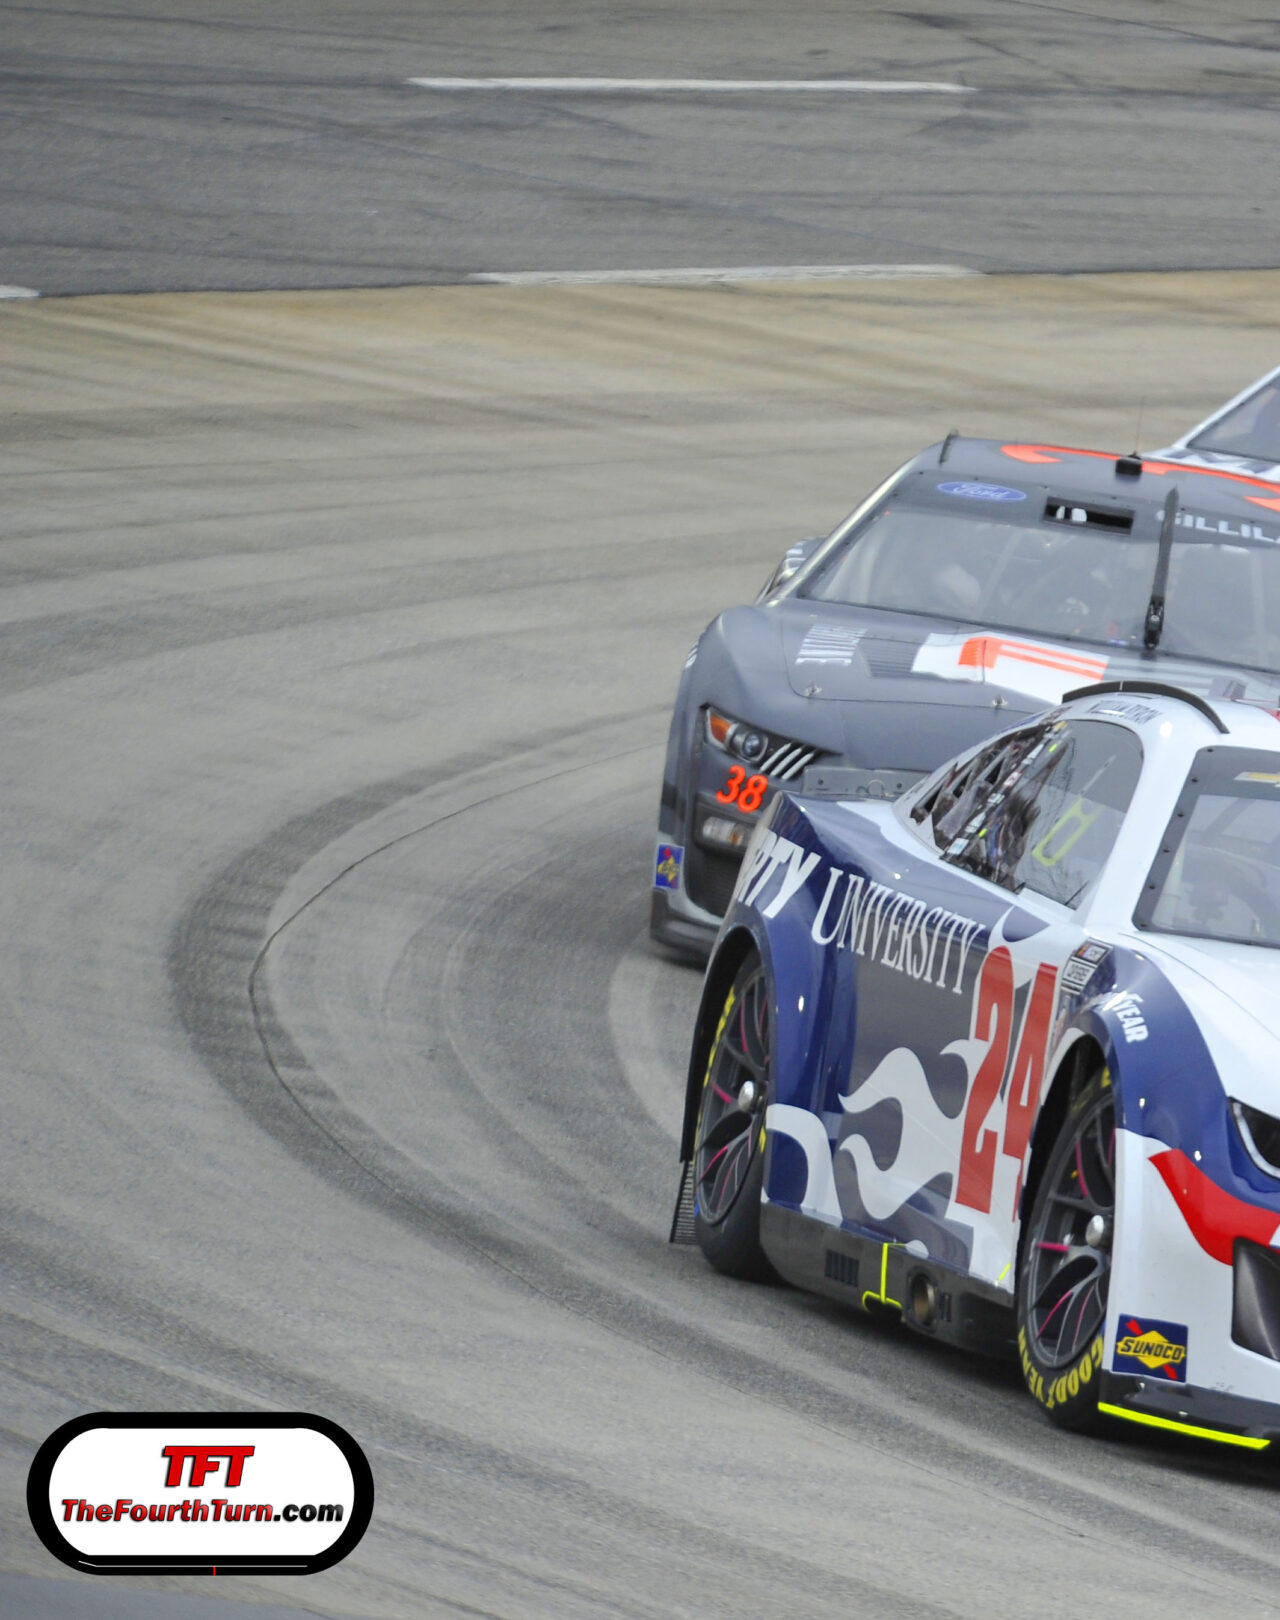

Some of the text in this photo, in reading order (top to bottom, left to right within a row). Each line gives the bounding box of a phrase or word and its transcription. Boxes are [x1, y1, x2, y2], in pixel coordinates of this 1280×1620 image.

[716, 765, 769, 814] 38
[811, 866, 987, 995] UNIVERSITY
[955, 945, 1060, 1223] 24
[1120, 1337, 1184, 1363] SUNOCO
